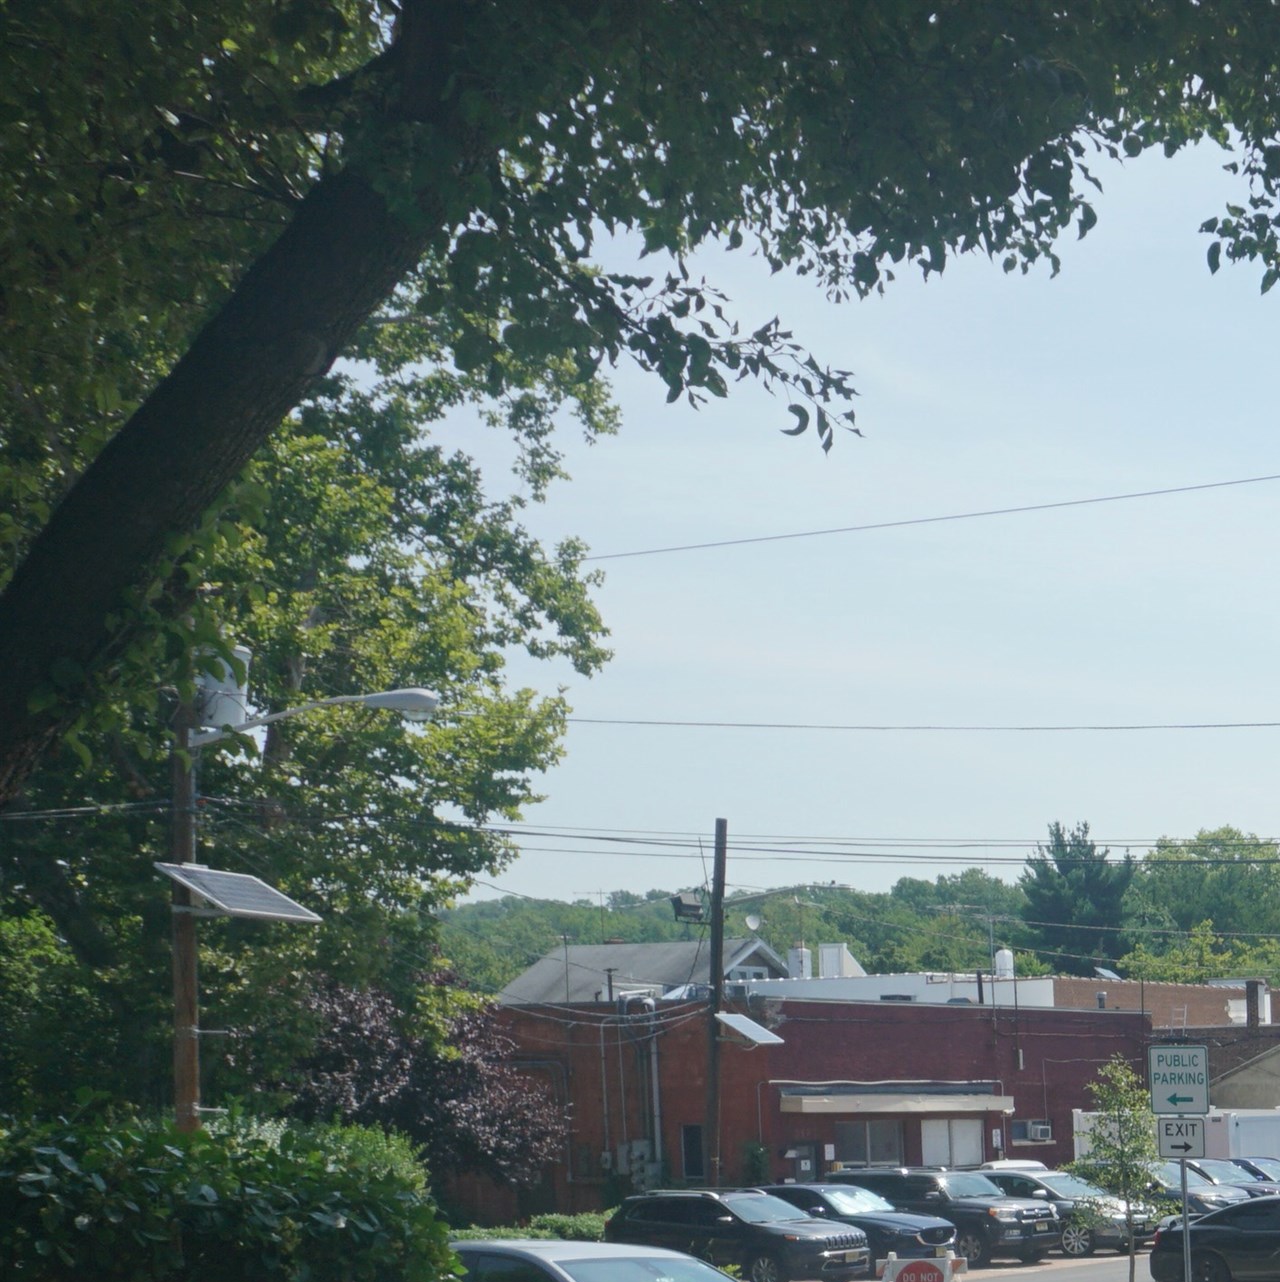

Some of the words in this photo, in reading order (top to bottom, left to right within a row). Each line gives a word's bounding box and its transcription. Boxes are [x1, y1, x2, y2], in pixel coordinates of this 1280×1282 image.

[1157, 1054, 1199, 1067] PUBLIC
[1153, 1072, 1204, 1085] PARKING
[1165, 1123, 1197, 1137] EXIT
[902, 1273, 916, 1282] DO
[920, 1272, 938, 1282] NOT
